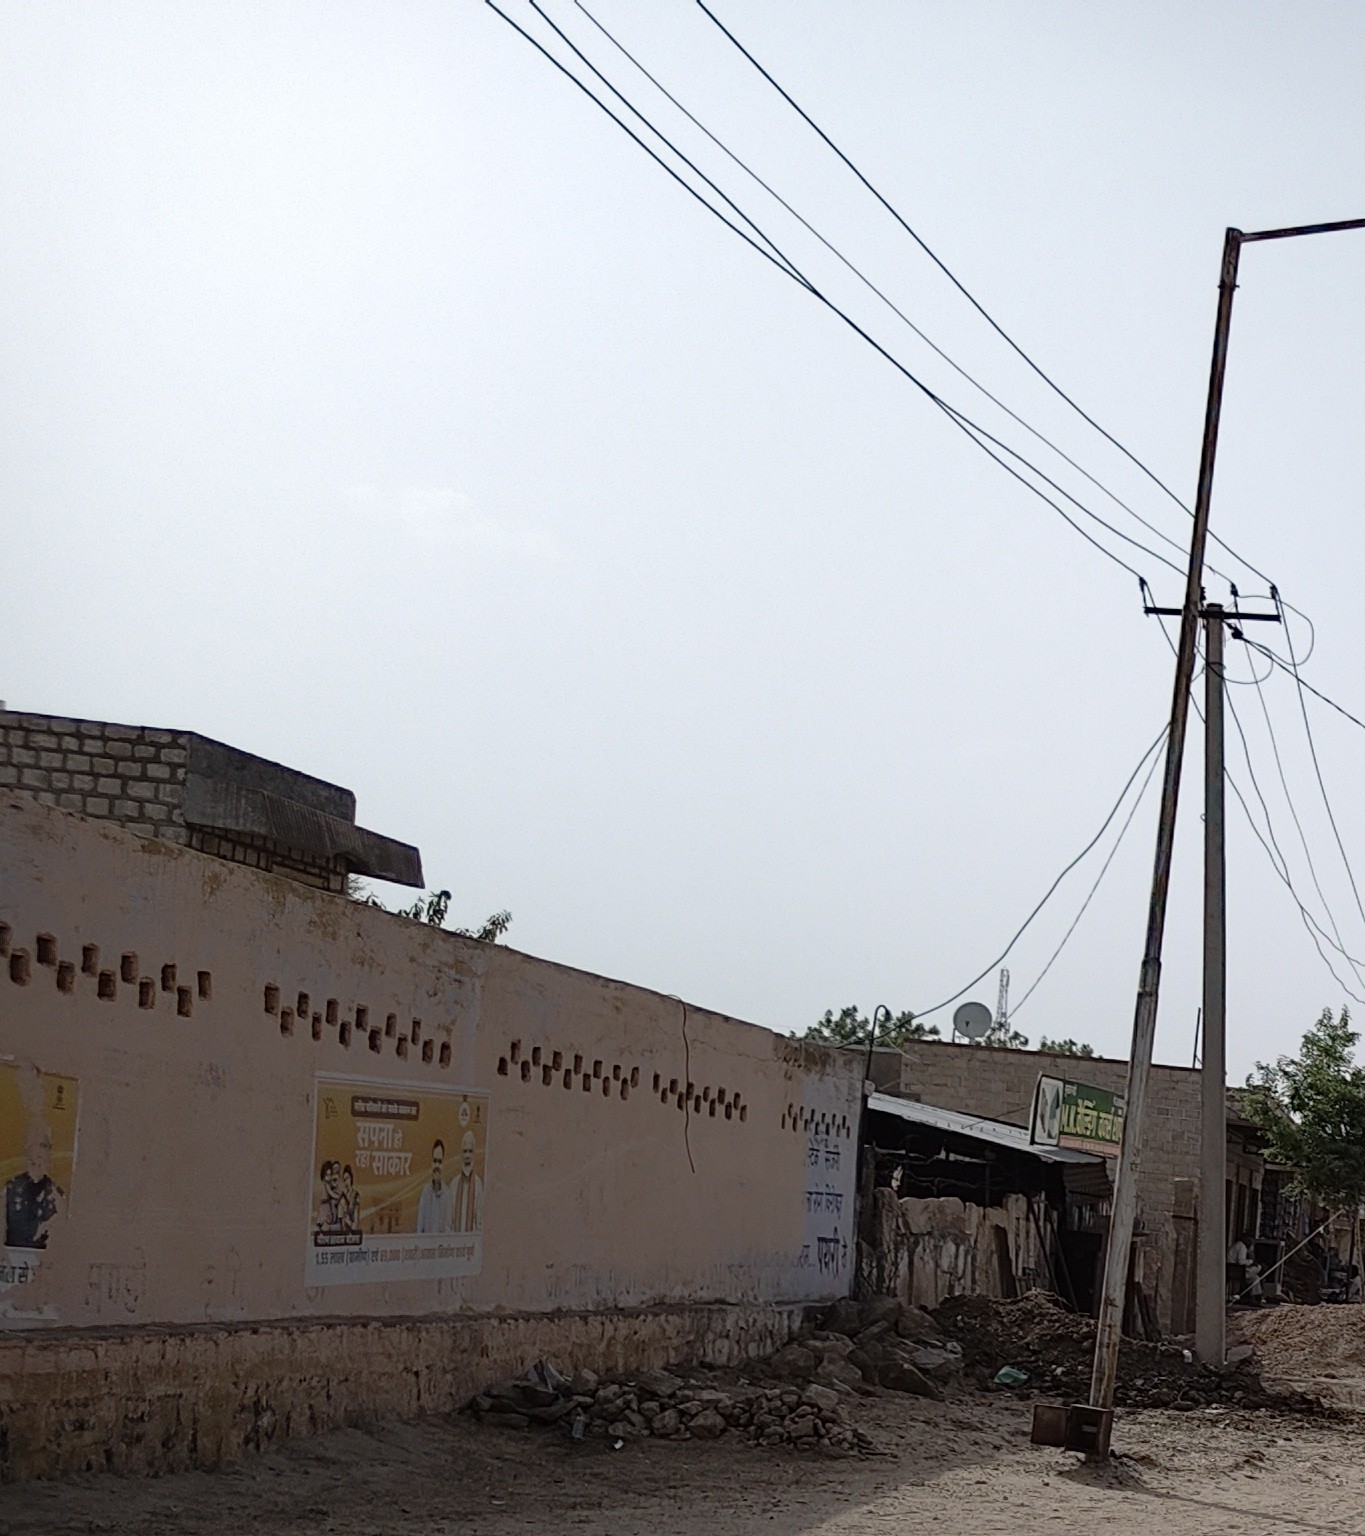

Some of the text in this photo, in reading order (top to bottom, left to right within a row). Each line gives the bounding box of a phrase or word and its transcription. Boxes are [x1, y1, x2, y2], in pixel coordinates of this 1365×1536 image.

[356, 1122, 394, 1149] सपना
[354, 1150, 413, 1176] रहा साकार
